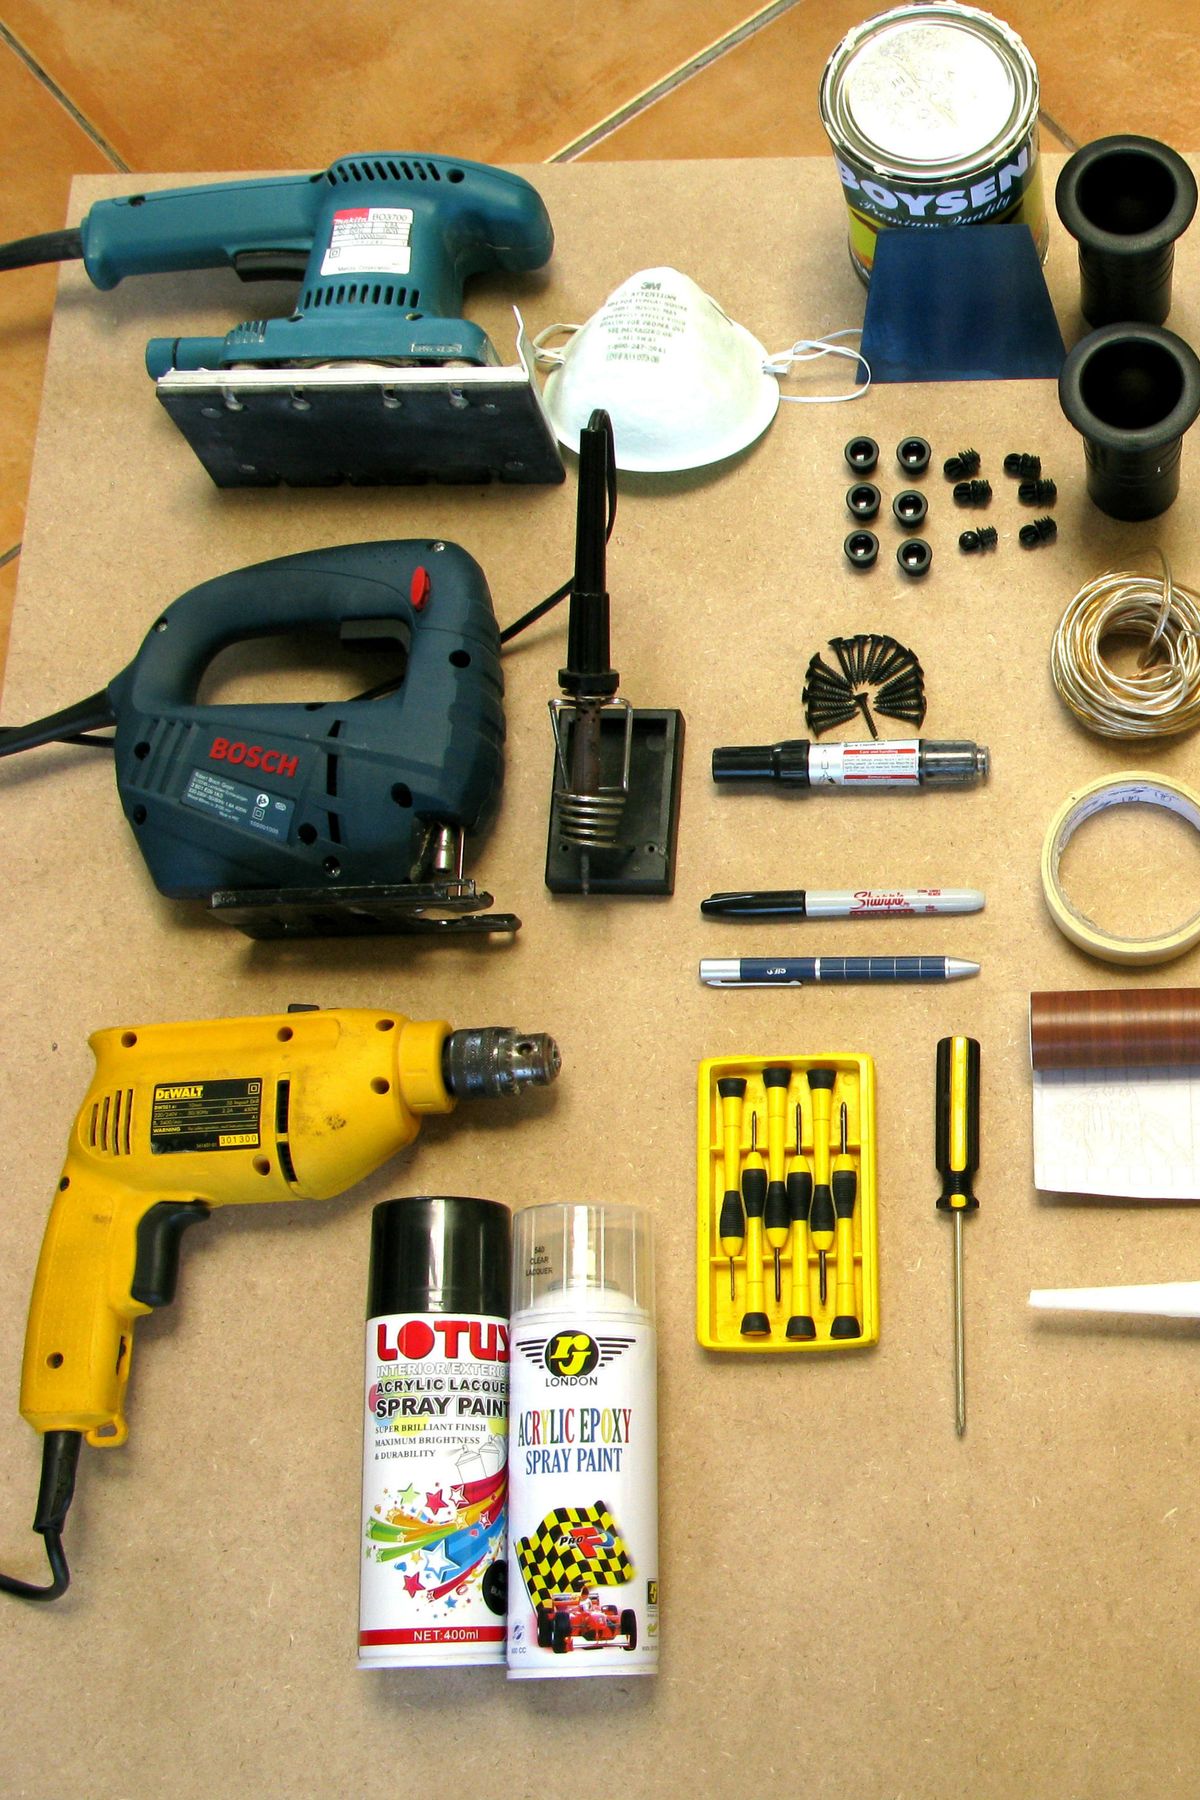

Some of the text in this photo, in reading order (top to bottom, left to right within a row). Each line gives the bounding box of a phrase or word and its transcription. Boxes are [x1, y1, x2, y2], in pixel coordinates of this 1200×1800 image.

[835, 149, 1029, 217] BOYSEN
[209, 737, 299, 778] BOSCH
[376, 1379, 444, 1394] ACRYLIC
[545, 1376, 598, 1387] LONDON
[376, 1396, 451, 1418] SPRAY
[375, 1423, 486, 1434] SUPER BRILLIANT FINISH
[518, 1407, 632, 1448] ACRYLIC EPOXY
[375, 1436, 480, 1447] MAXIMUM BRIGHTNESS
[380, 1450, 437, 1460] DURABILITY
[526, 1447, 623, 1475] SPRAY PAINT
